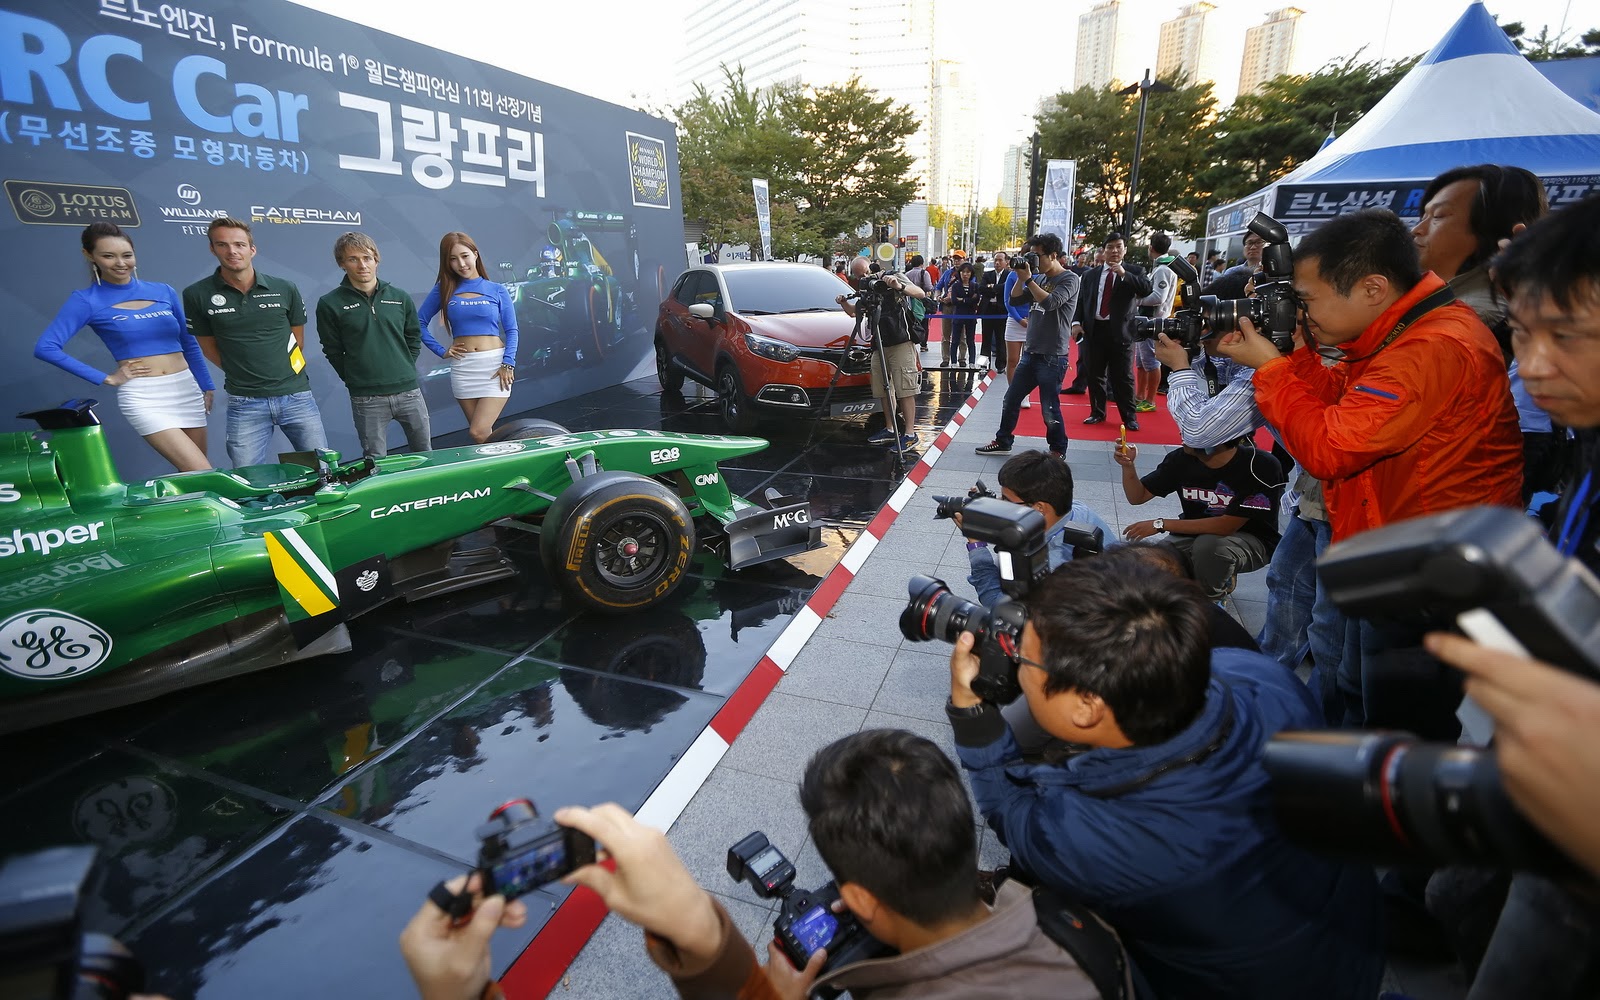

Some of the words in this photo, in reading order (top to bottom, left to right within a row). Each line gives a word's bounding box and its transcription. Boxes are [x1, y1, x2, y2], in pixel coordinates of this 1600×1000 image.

[0, 10, 152, 121] RC
[172, 55, 309, 143] Car
[231, 23, 333, 74] Formula
[365, 58, 460, 104] 월드챔피언십
[464, 86, 493, 112] 11회
[496, 94, 543, 124] 선정기념
[0, 111, 157, 159] (무선조종
[173, 135, 310, 175] 모형자동차)
[338, 91, 546, 198] 그랑프리
[638, 154, 659, 167] WORLD
[633, 165, 665, 180] CHAMPION
[58, 193, 127, 208] LOTUS
[88, 208, 132, 219] TEAM
[159, 207, 229, 219] WILLIAMS
[250, 205, 361, 222] CATERHAM
[268, 217, 302, 225] TEAM
[1208, 379, 1217, 395] EOS
[842, 403, 876, 413] QM3
[650, 447, 680, 463] EQ8
[695, 472, 719, 486] CNN
[370, 487, 491, 519] CATERHAM
[773, 509, 809, 530] McG
[566, 515, 592, 571] PIRELLI
